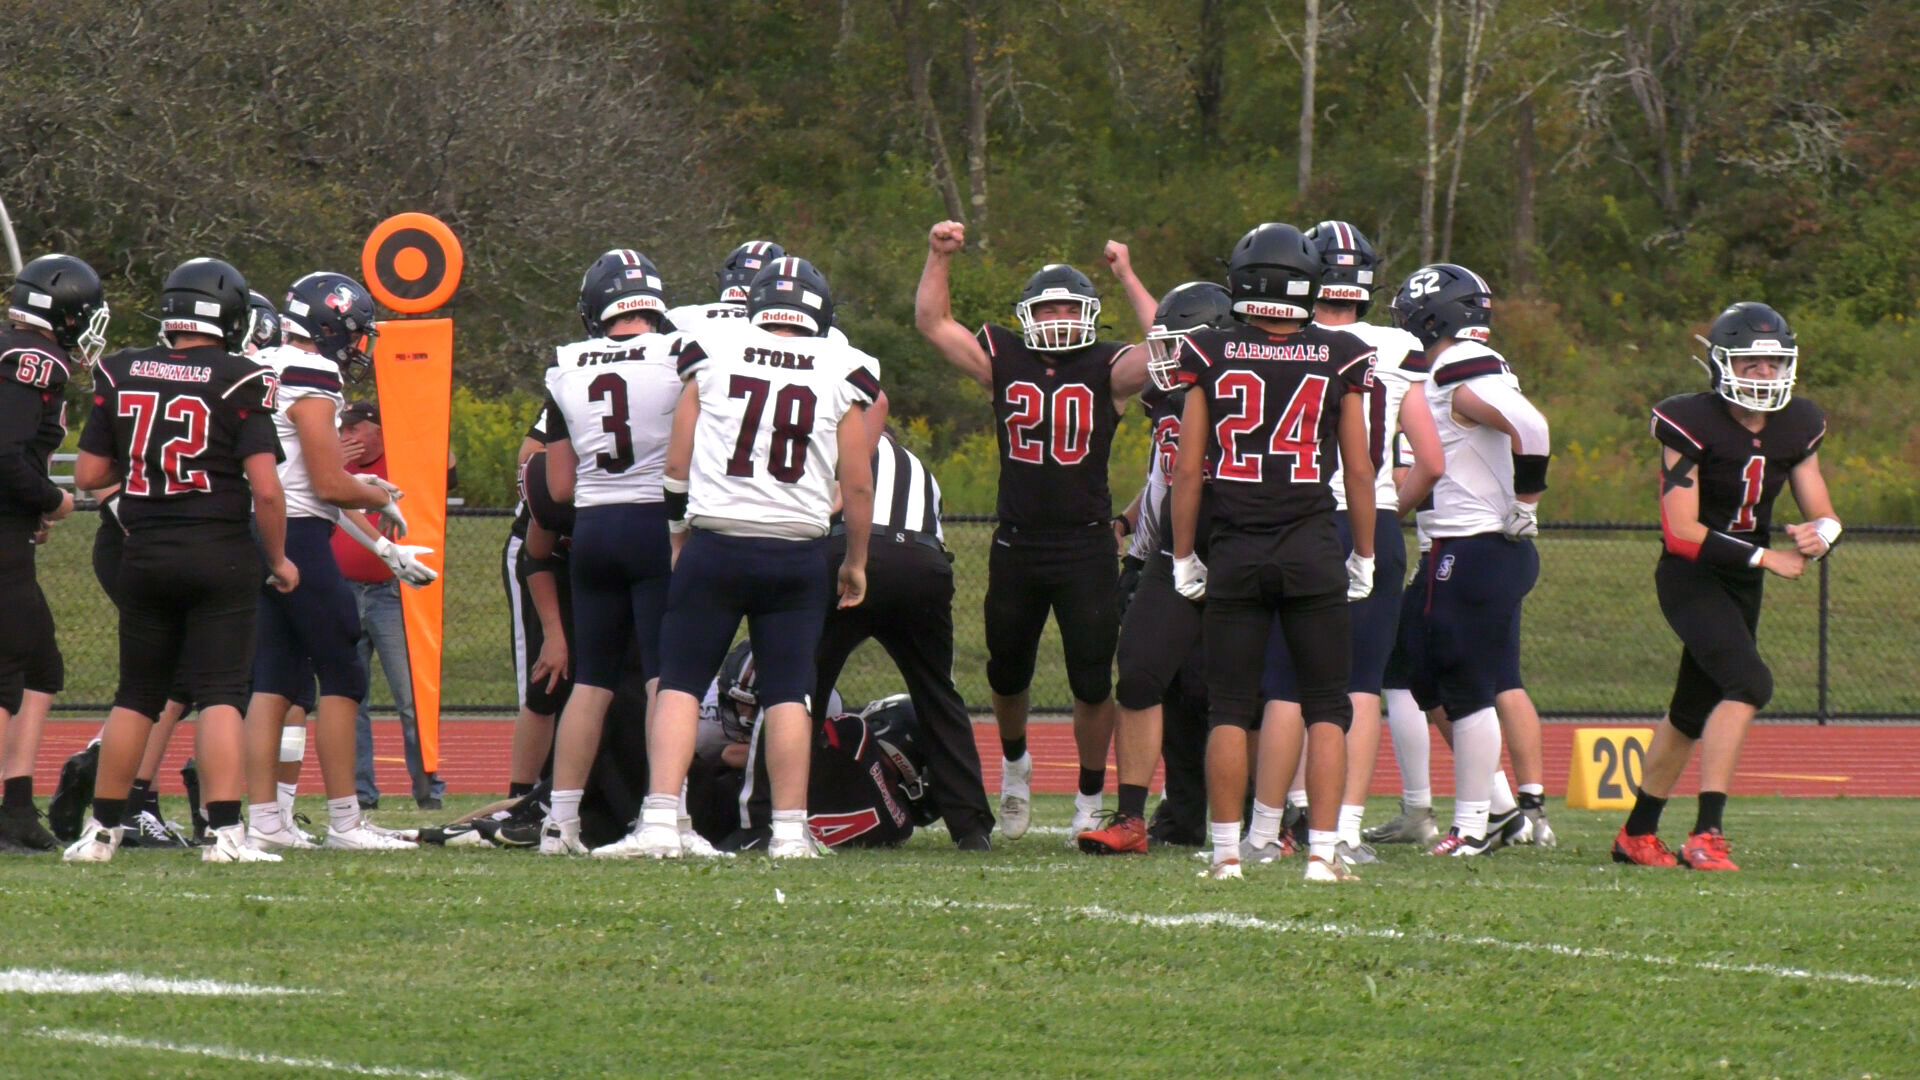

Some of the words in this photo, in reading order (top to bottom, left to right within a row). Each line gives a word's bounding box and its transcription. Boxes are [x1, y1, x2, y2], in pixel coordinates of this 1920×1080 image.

[1322, 287, 1363, 298] Riddell
[1409, 272, 1441, 299] 52
[617, 299, 657, 311] Riddell
[706, 307, 748, 319] STO
[1246, 303, 1294, 317] Riddell
[164, 321, 198, 331] Riddell
[762, 311, 803, 323] Riddell
[577, 346, 647, 367] STORM
[743, 347, 815, 370] STORM
[1224, 342, 1330, 361] CARDINALS
[16, 353, 54, 388] 61
[129, 360, 212, 382] CARDINALS
[588, 372, 635, 474] 3
[726, 374, 818, 484] 78
[1004, 380, 1094, 466] 20
[1215, 369, 1330, 483] 24
[117, 391, 212, 496] 72
[1728, 455, 1766, 532] 1
[896, 532, 905, 543] S
[1593, 736, 1645, 799] 20
